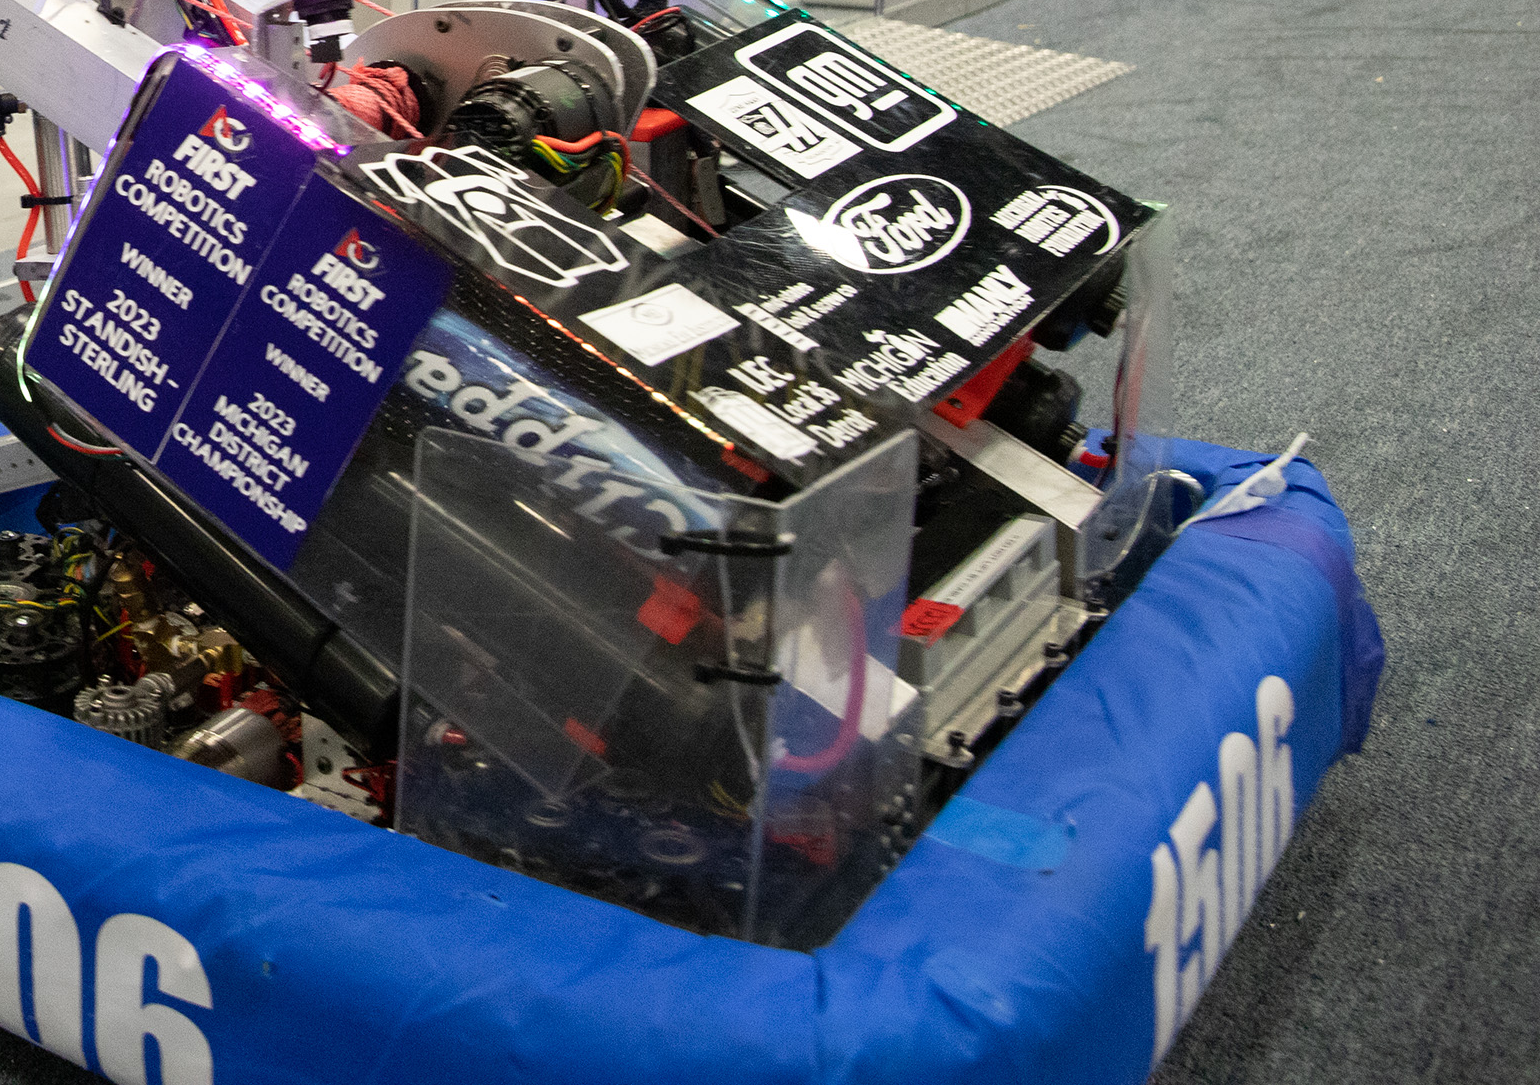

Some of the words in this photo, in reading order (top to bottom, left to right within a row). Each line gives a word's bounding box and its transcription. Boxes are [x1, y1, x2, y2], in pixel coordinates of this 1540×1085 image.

[145, 159, 249, 245] ROBOTICS
[172, 133, 258, 202] FIRST
[115, 174, 253, 286] COMPETITION
[841, 189, 955, 263] Ford
[120, 242, 194, 310] WINNER
[286, 273, 380, 350] ROBOTICS
[310, 253, 386, 312] FIRST
[105, 289, 162, 342] 2023
[260, 284, 385, 384] COMPETITION
[59, 323, 157, 413] STERLING
[265, 341, 331, 403] WINNER
[886, 351, 972, 403] Education
[213, 395, 310, 479] MICHIGAN
[247, 392, 297, 437] 2023
[806, 408, 879, 449] Detroit
[172, 422, 308, 534] CHAMPIONSHIP
[208, 421, 292, 493] DISTRICT
[1143, 674, 1295, 1082] 1506
